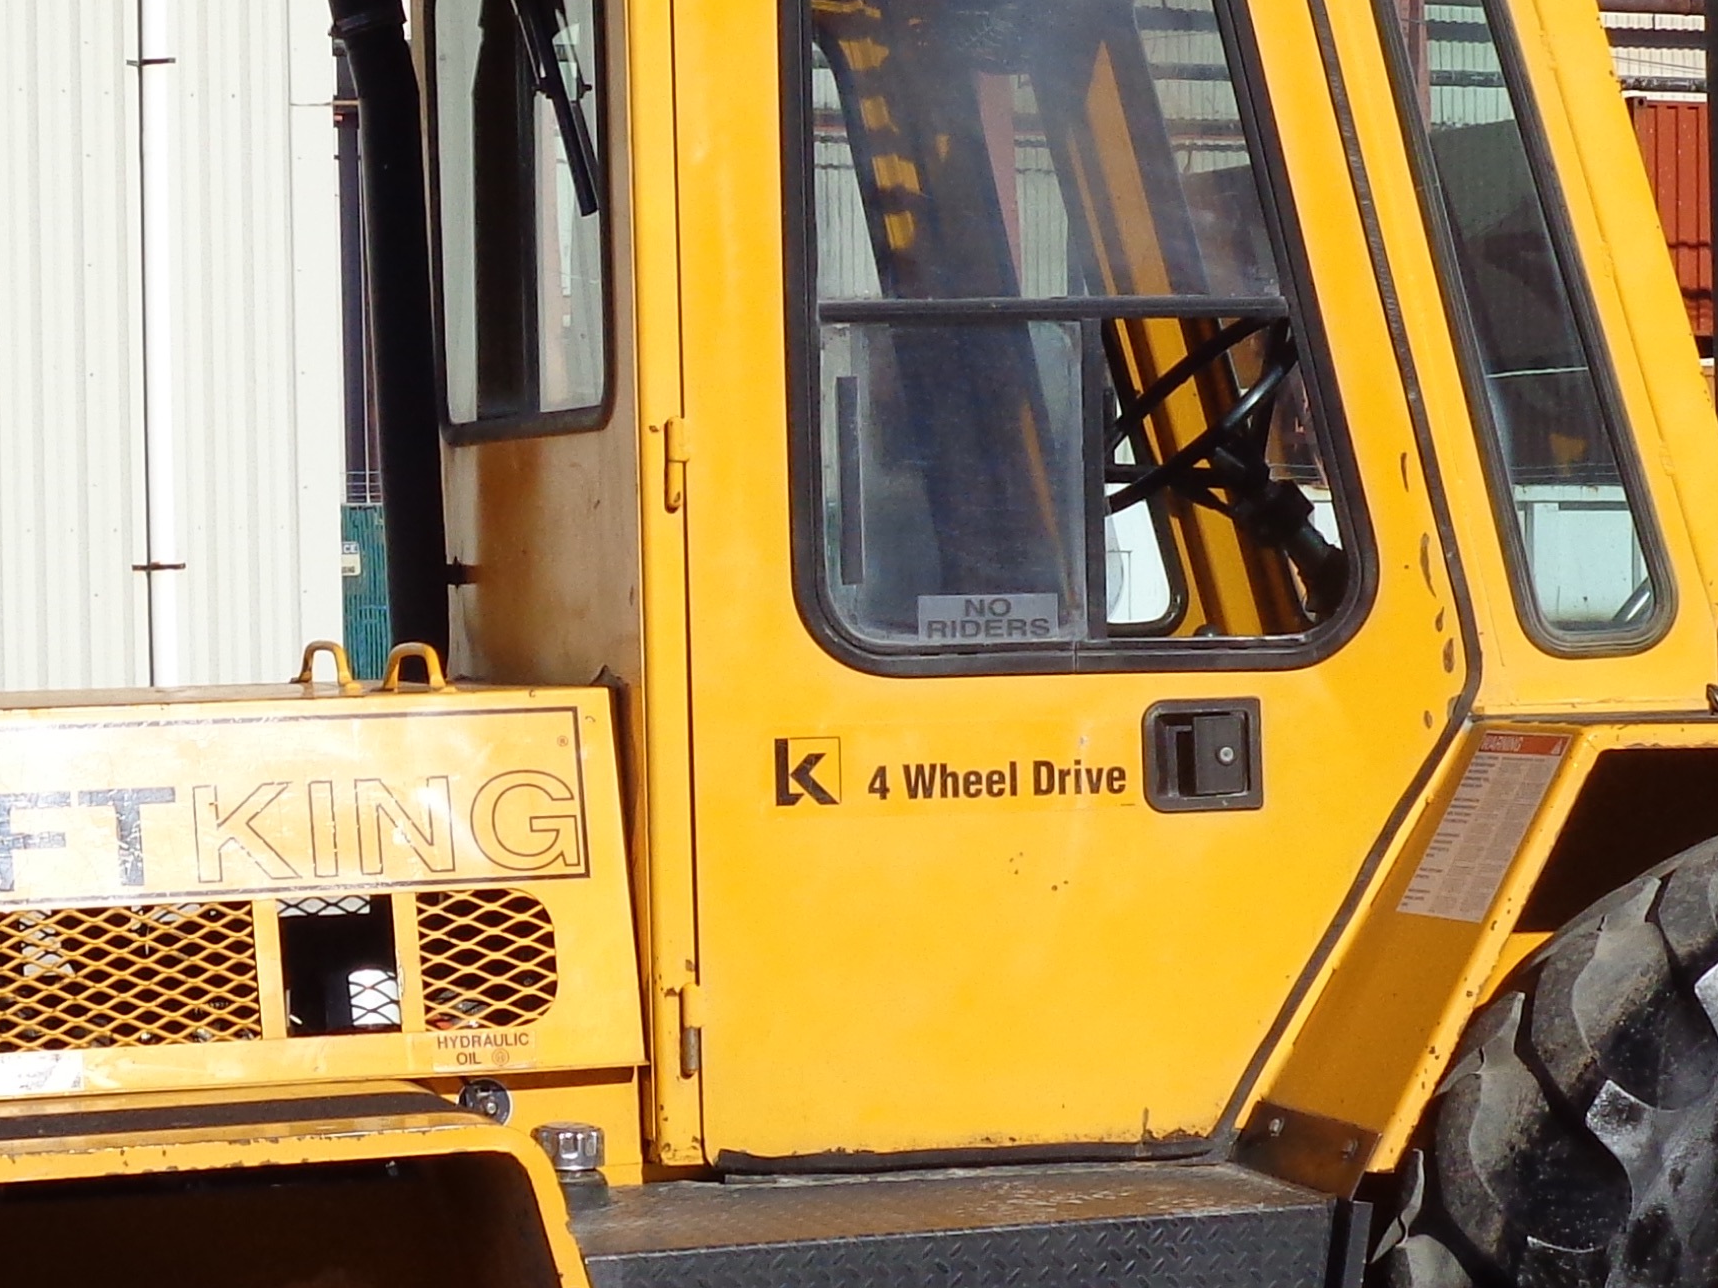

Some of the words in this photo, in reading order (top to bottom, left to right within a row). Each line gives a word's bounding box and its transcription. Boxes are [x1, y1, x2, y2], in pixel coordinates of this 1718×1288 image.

[965, 598, 1012, 616] NO
[927, 617, 1050, 639] RIDERS
[868, 765, 890, 800] 4
[902, 761, 1018, 799] Wheel
[1033, 759, 1126, 796] Drive
[437, 1033, 529, 1050] HYDRAULIC
[456, 1052, 482, 1065] OIL
